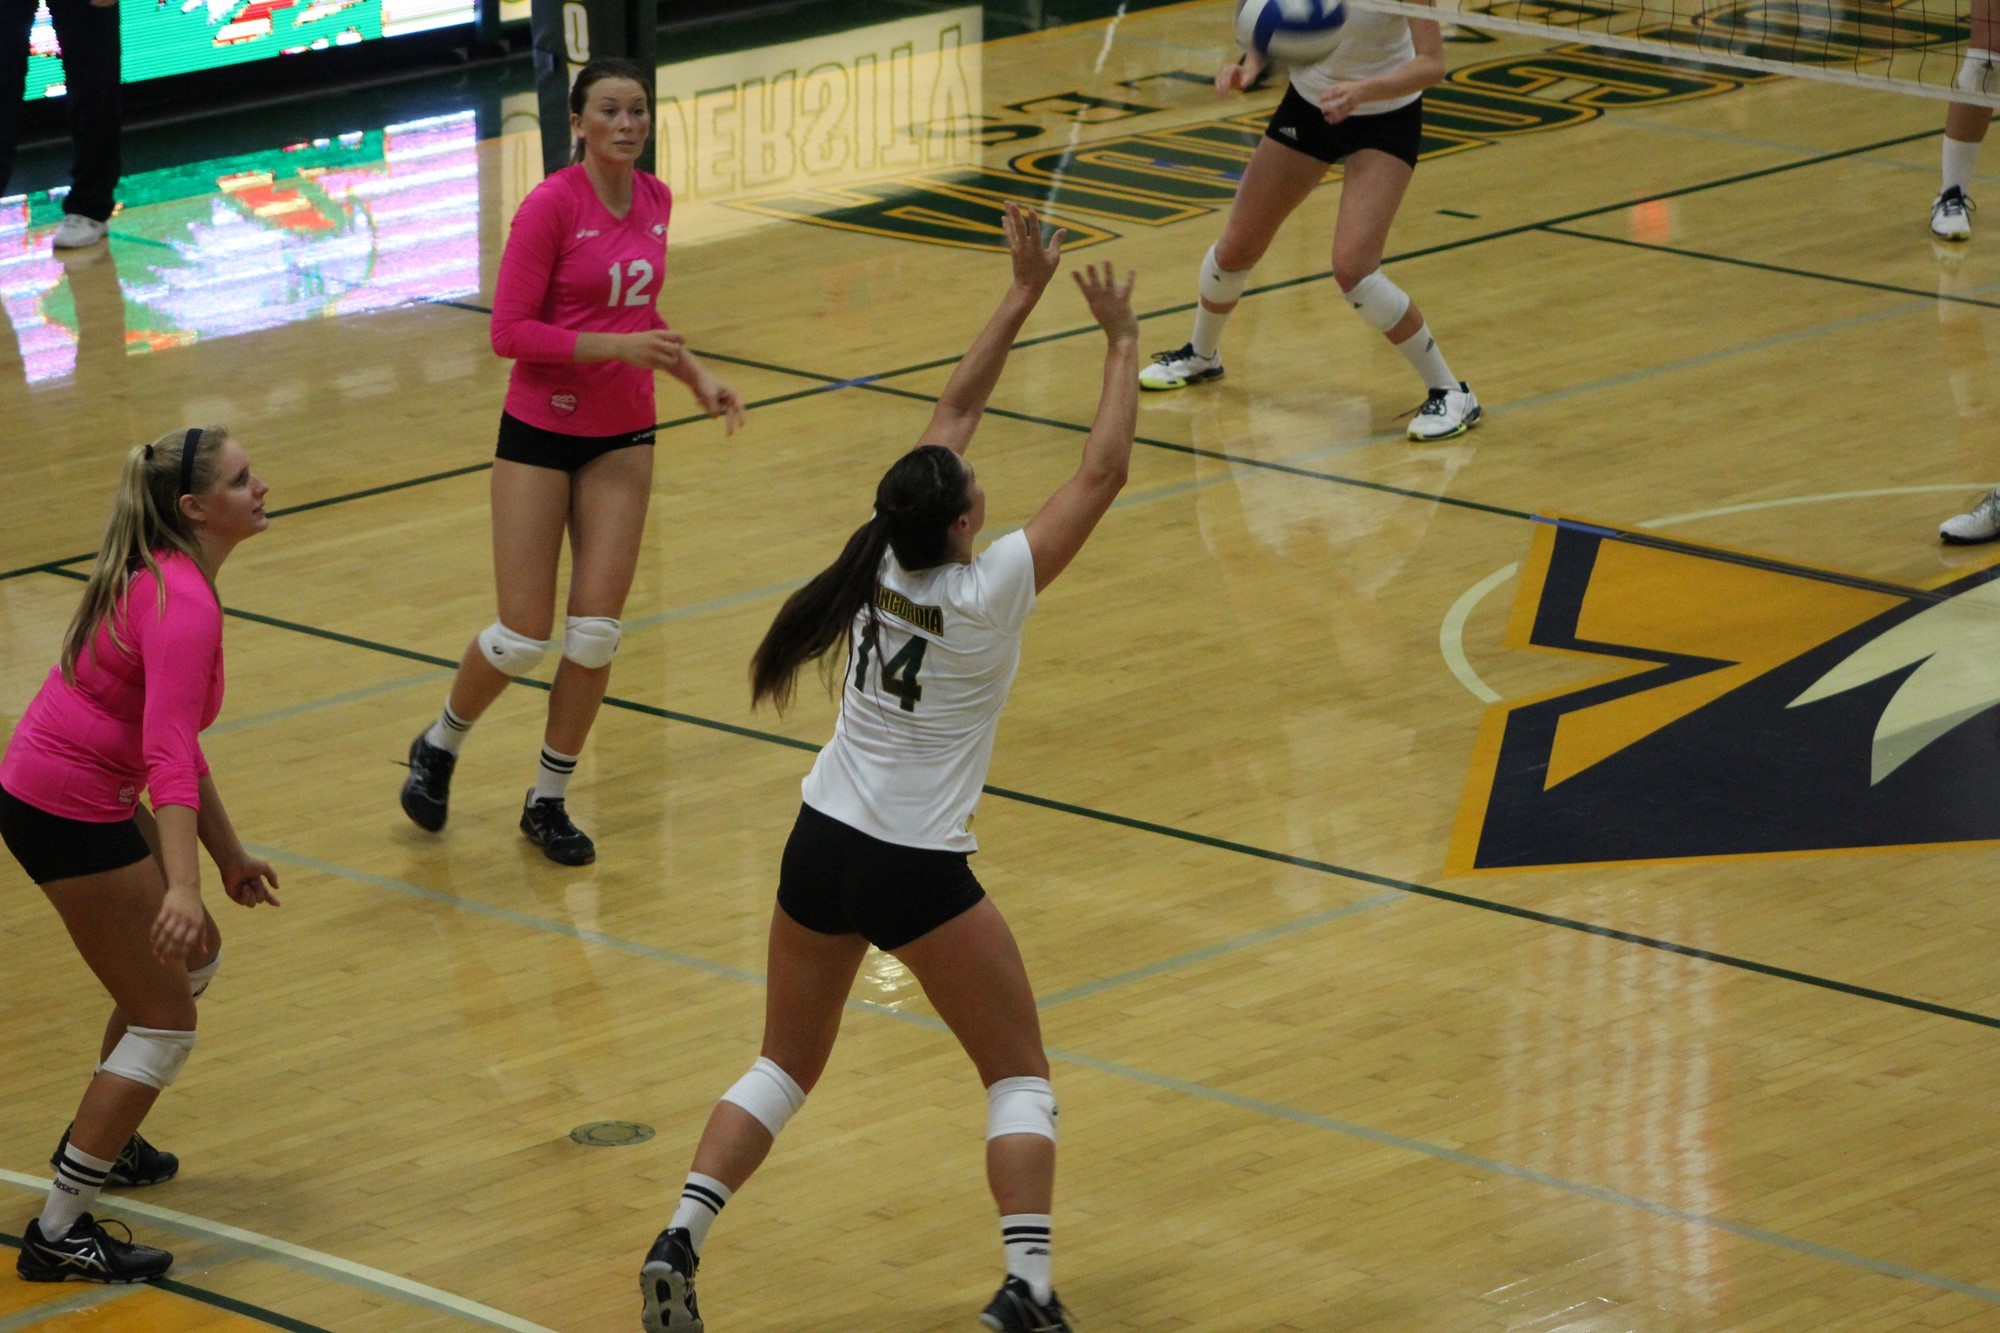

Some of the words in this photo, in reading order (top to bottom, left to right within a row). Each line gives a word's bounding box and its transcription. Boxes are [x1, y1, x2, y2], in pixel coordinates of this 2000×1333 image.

[607, 259, 654, 307] 12
[873, 584, 944, 637] NCORDIA
[853, 622, 928, 713] 14
